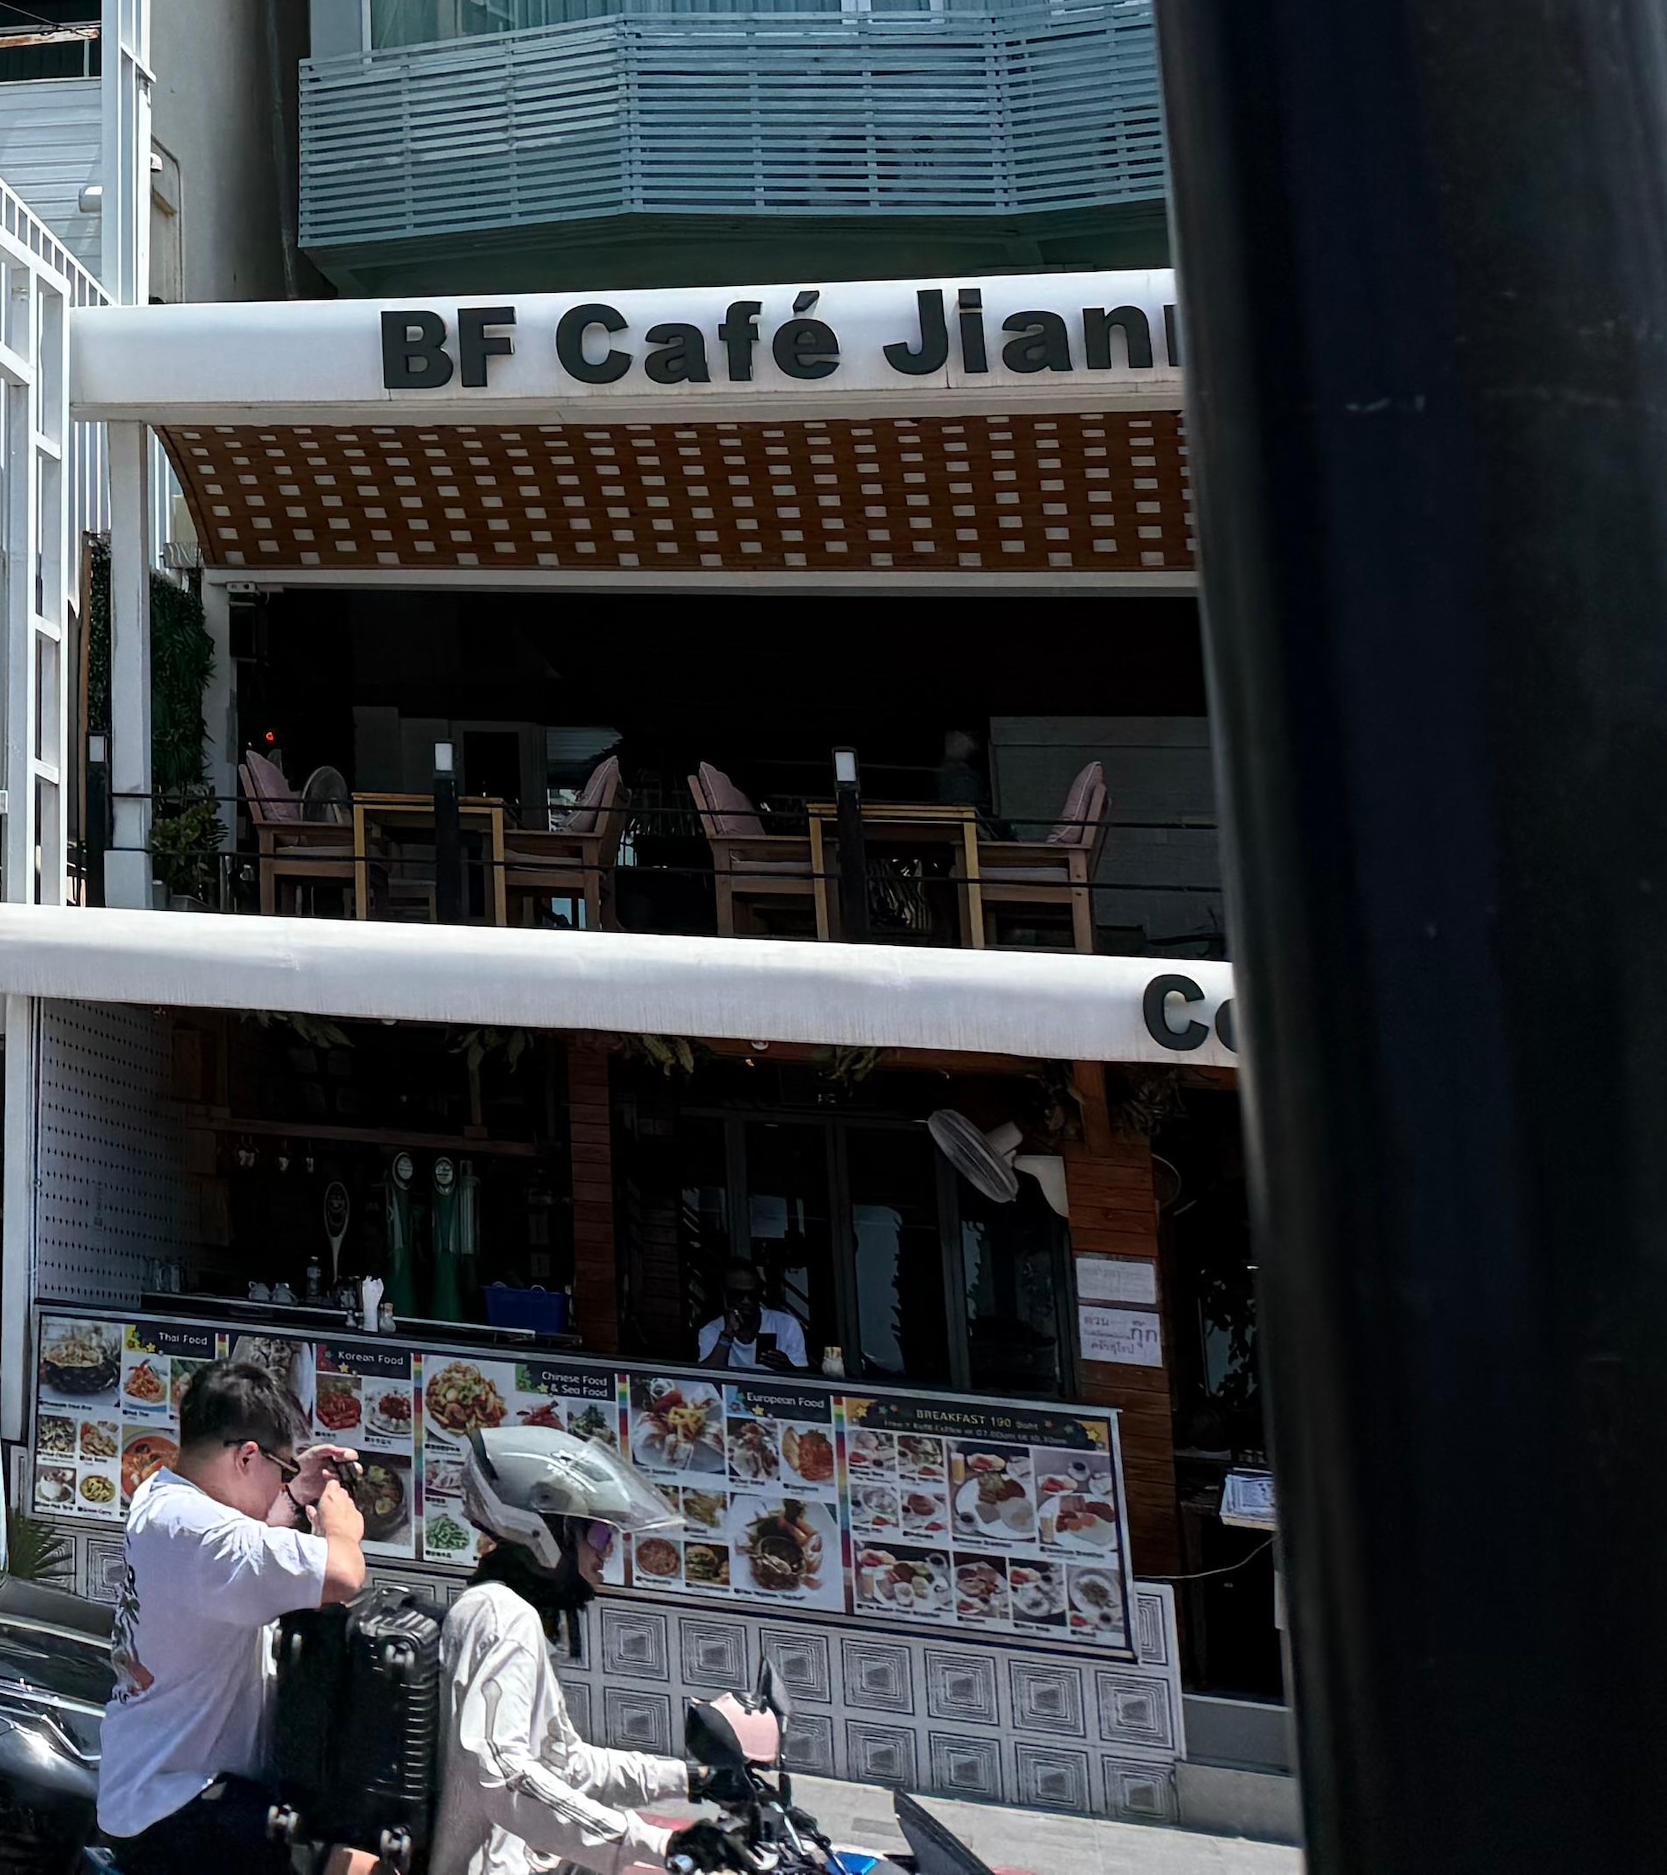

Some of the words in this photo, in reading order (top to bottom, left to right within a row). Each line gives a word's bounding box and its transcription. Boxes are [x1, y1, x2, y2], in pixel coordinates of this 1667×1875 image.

[380, 305, 517, 390] BF
[554, 290, 840, 386] Café
[158, 1331, 180, 1343] Thai
[183, 1333, 208, 1346] Food
[338, 1351, 375, 1362] Korean
[378, 1355, 404, 1365] Food
[542, 1371, 580, 1385] Chinese
[582, 1375, 608, 1387] Food
[561, 1384, 581, 1395] Sea
[583, 1386, 608, 1397] Food
[746, 1391, 796, 1407] European
[798, 1398, 826, 1410] Food
[916, 1409, 986, 1426] BREAKFAST
